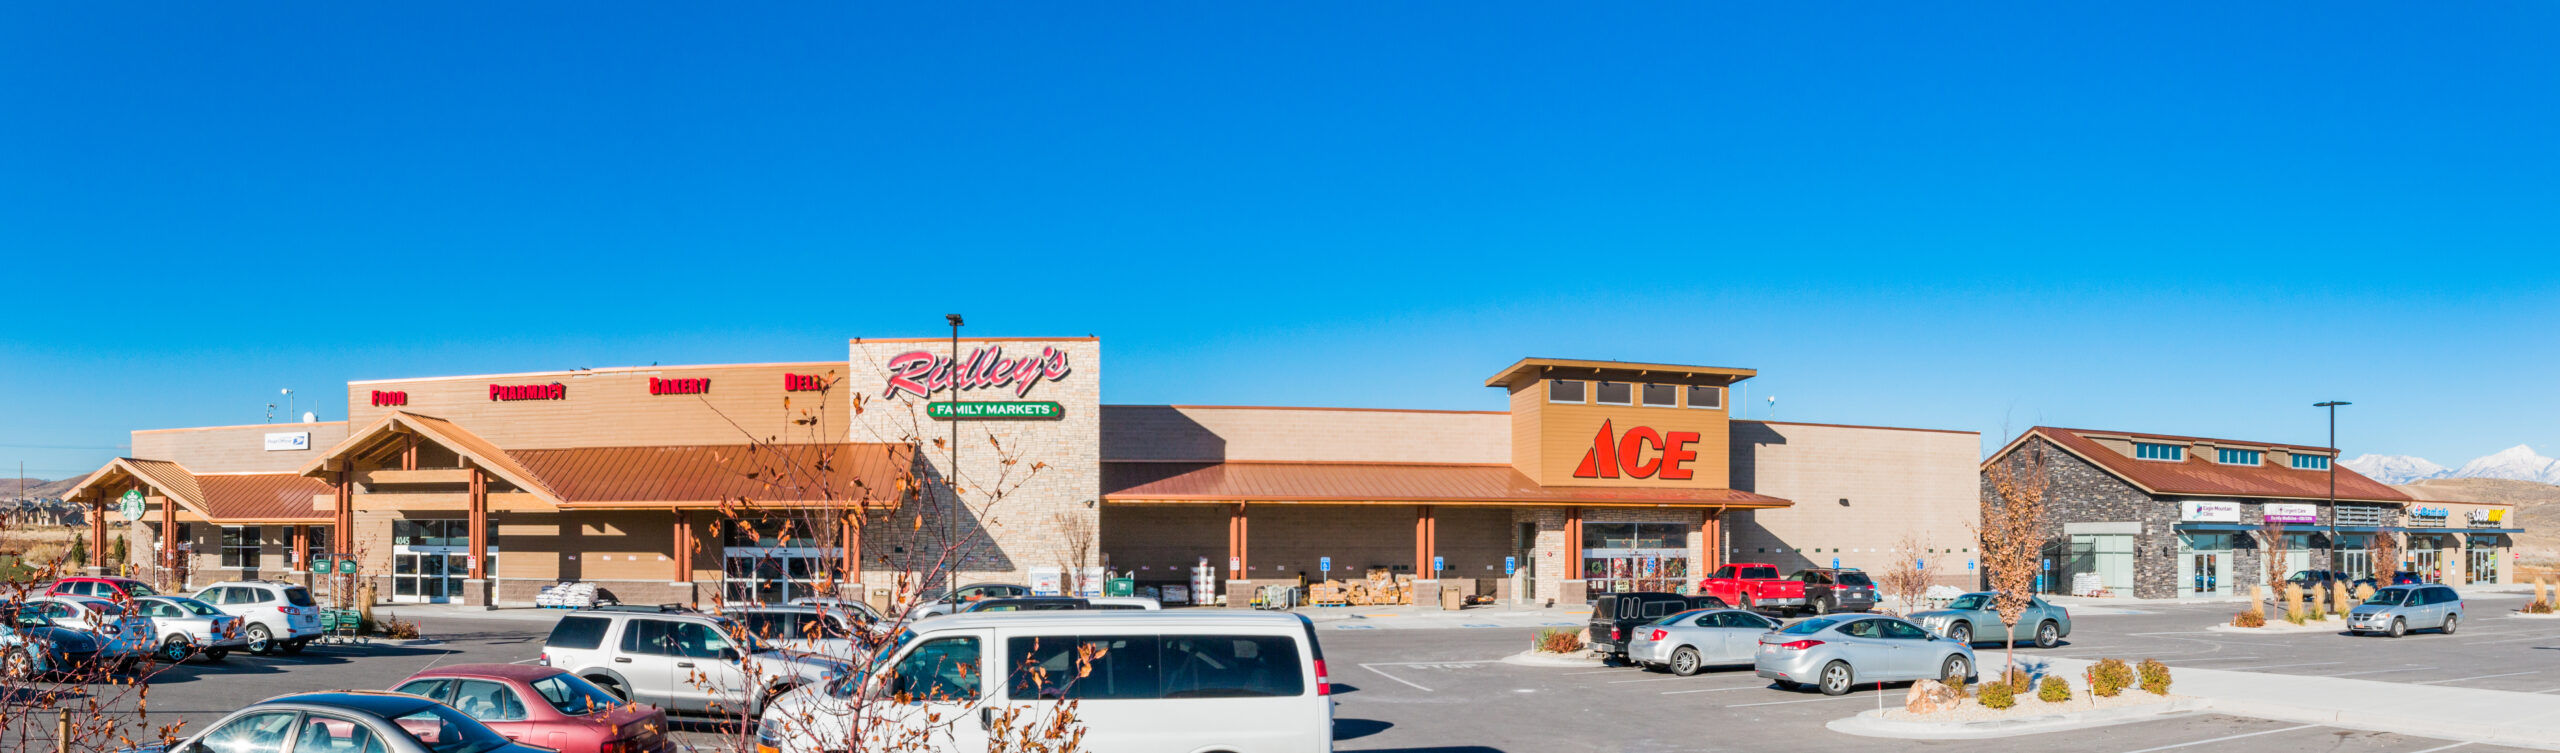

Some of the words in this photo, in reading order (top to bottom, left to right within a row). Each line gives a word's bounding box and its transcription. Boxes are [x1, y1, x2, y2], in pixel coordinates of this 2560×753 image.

[883, 345, 1069, 399] Ridley's
[489, 383, 565, 400] PHARMACY
[649, 377, 710, 394] BAKERY
[371, 390, 407, 406] FOOD
[937, 404, 984, 415] FAMILY
[986, 404, 1050, 415] MARKETS
[1572, 417, 1700, 480] ACE
[395, 536, 410, 545] 4045
